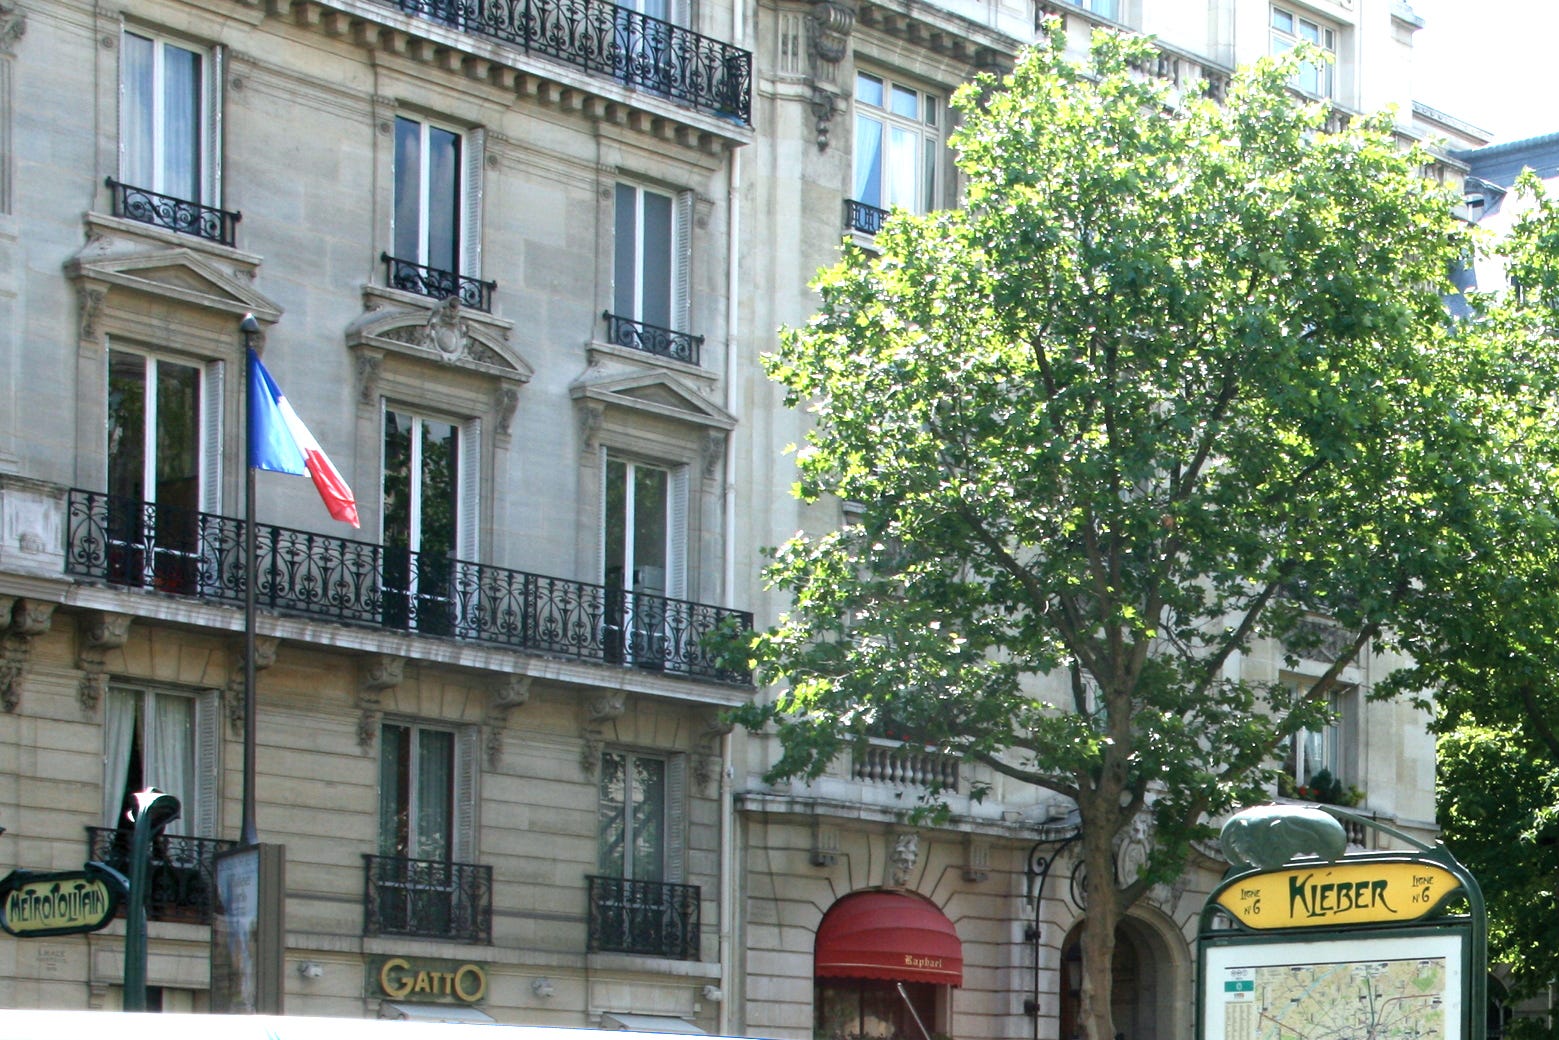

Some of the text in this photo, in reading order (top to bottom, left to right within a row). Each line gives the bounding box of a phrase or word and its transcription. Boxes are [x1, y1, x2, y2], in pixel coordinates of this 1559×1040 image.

[1240, 887, 1261, 900] LIGNE
[1288, 871, 1398, 919] KLÉBER
[1412, 874, 1434, 888] LIGNE
[10, 881, 105, 926] METROPOLITAIN
[904, 954, 942, 969] Raphael
[381, 957, 487, 1002] GATTO
